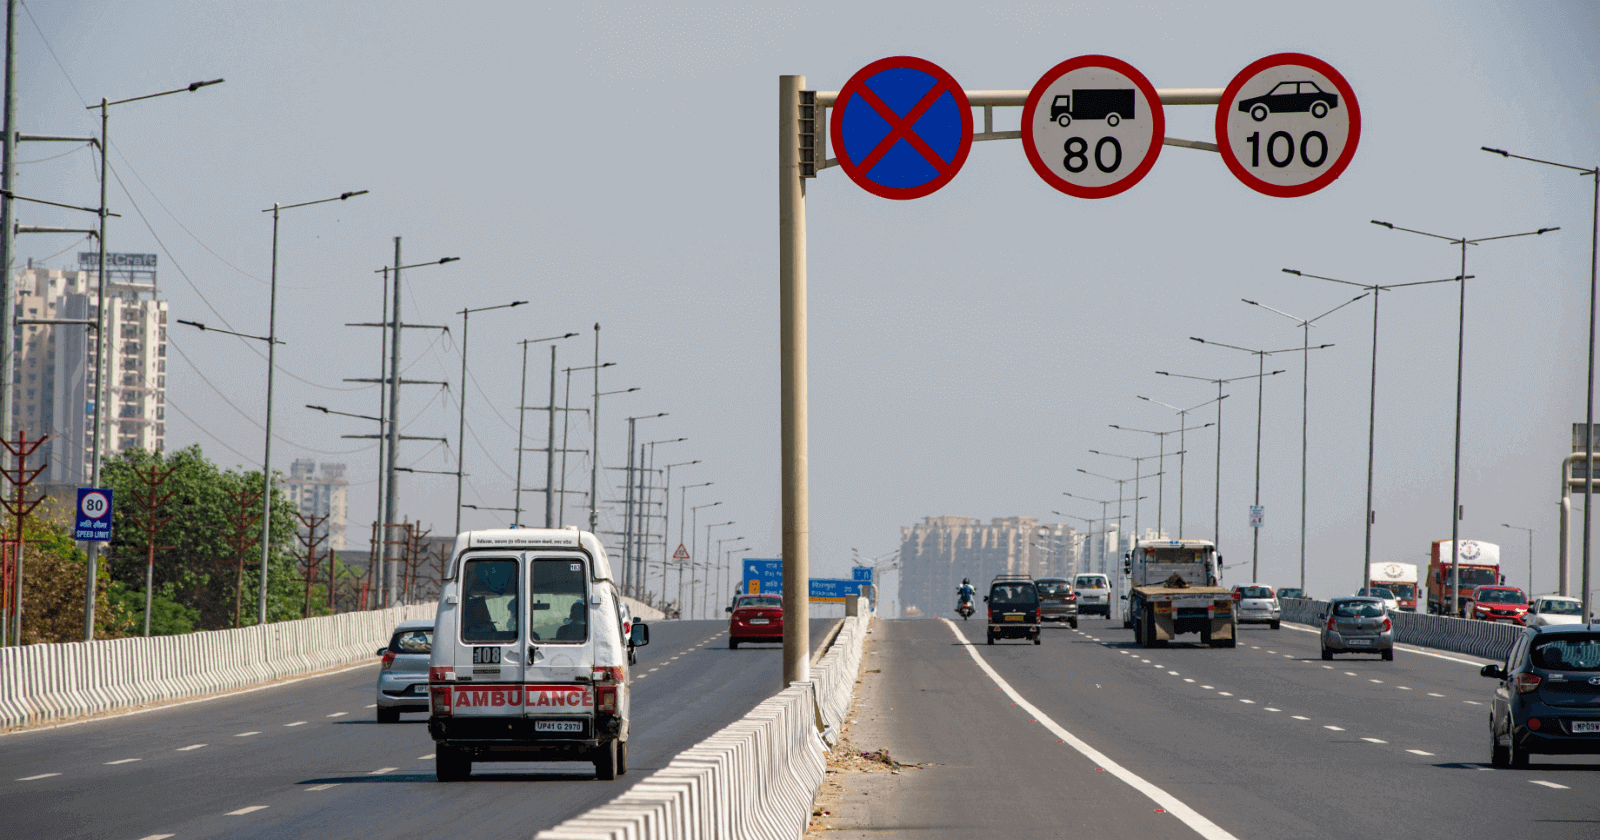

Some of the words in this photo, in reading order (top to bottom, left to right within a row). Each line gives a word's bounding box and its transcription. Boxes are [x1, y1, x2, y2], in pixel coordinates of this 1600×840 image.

[1063, 136, 1122, 173] 80
[1246, 130, 1328, 168] 100
[86, 499, 103, 511] 80
[475, 647, 500, 663] 108
[455, 691, 593, 707] AMBULANCE
[537, 722, 555, 730] UP41
[564, 723, 581, 731] 2970
